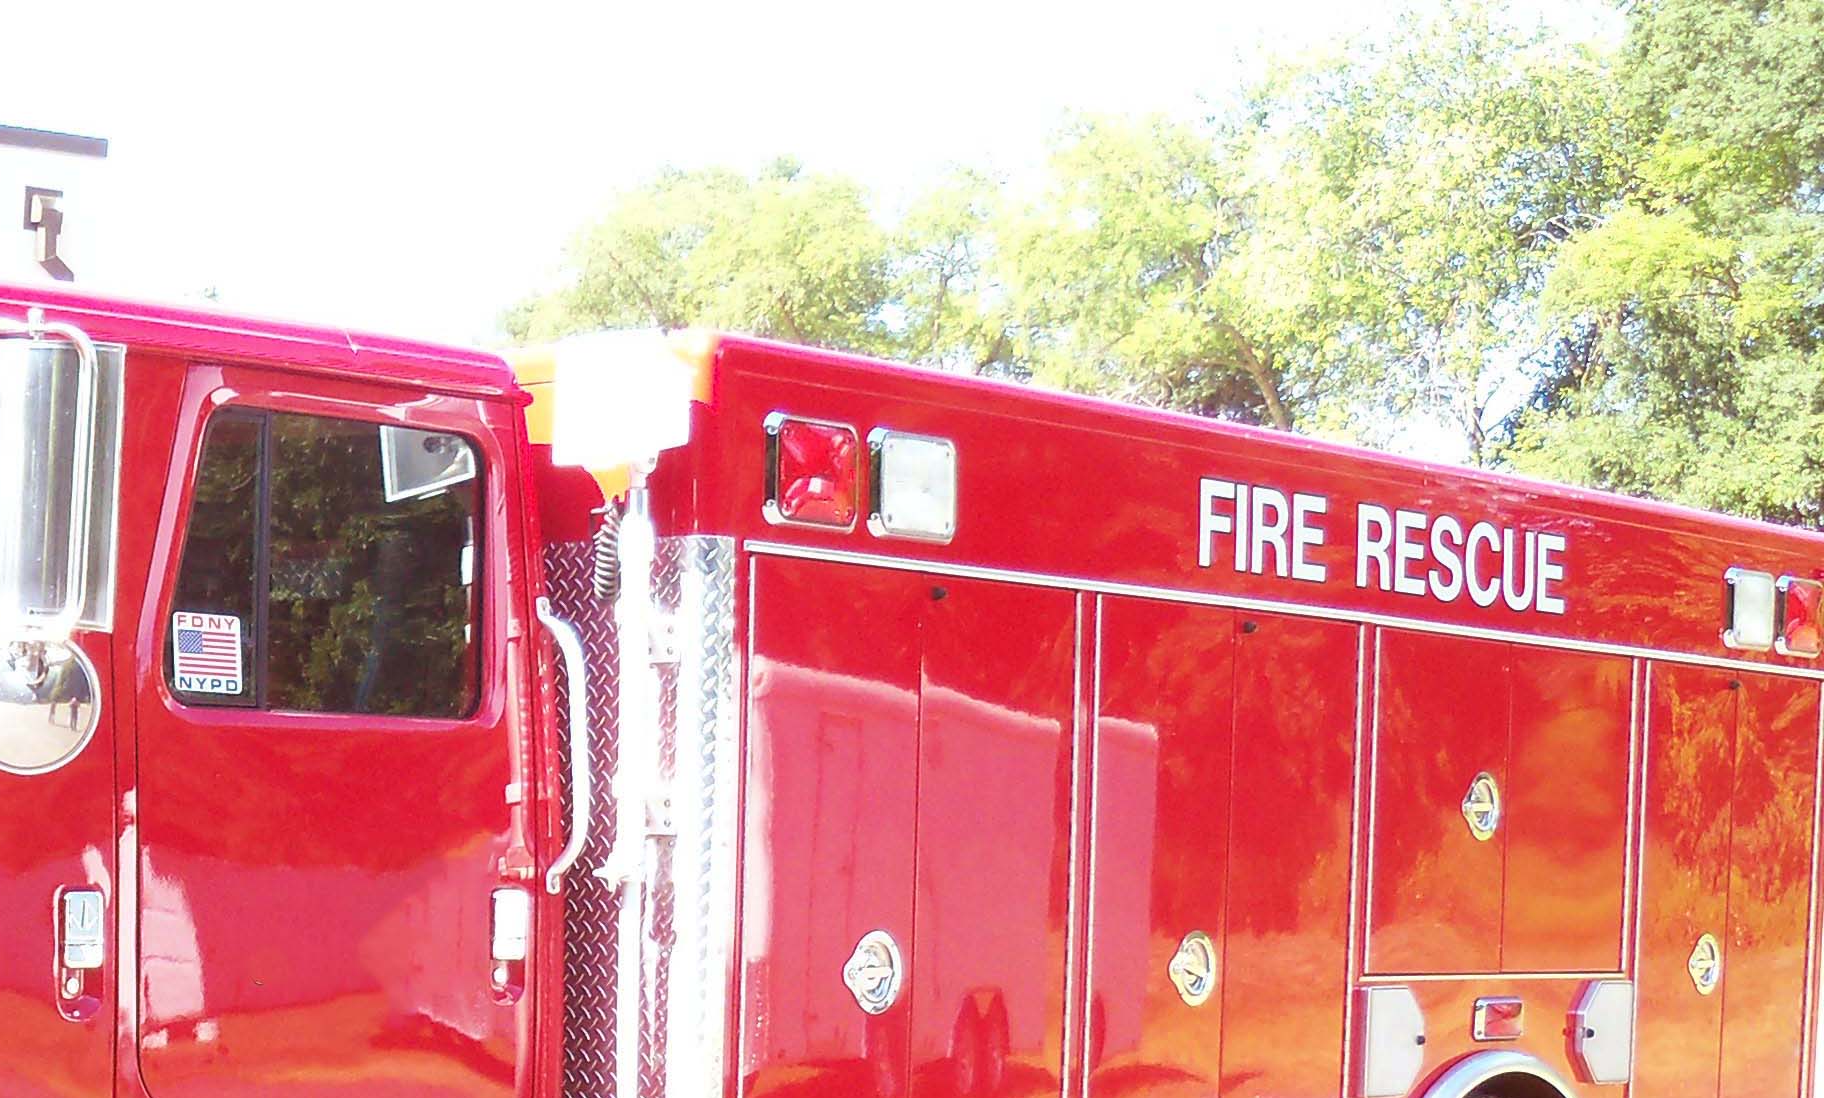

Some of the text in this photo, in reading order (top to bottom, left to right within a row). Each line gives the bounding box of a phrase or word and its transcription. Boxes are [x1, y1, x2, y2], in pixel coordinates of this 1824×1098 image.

[1198, 476, 1566, 615] FIRE RESCUE
[177, 614, 235, 630] FDNY
[179, 676, 238, 692] NYPD
